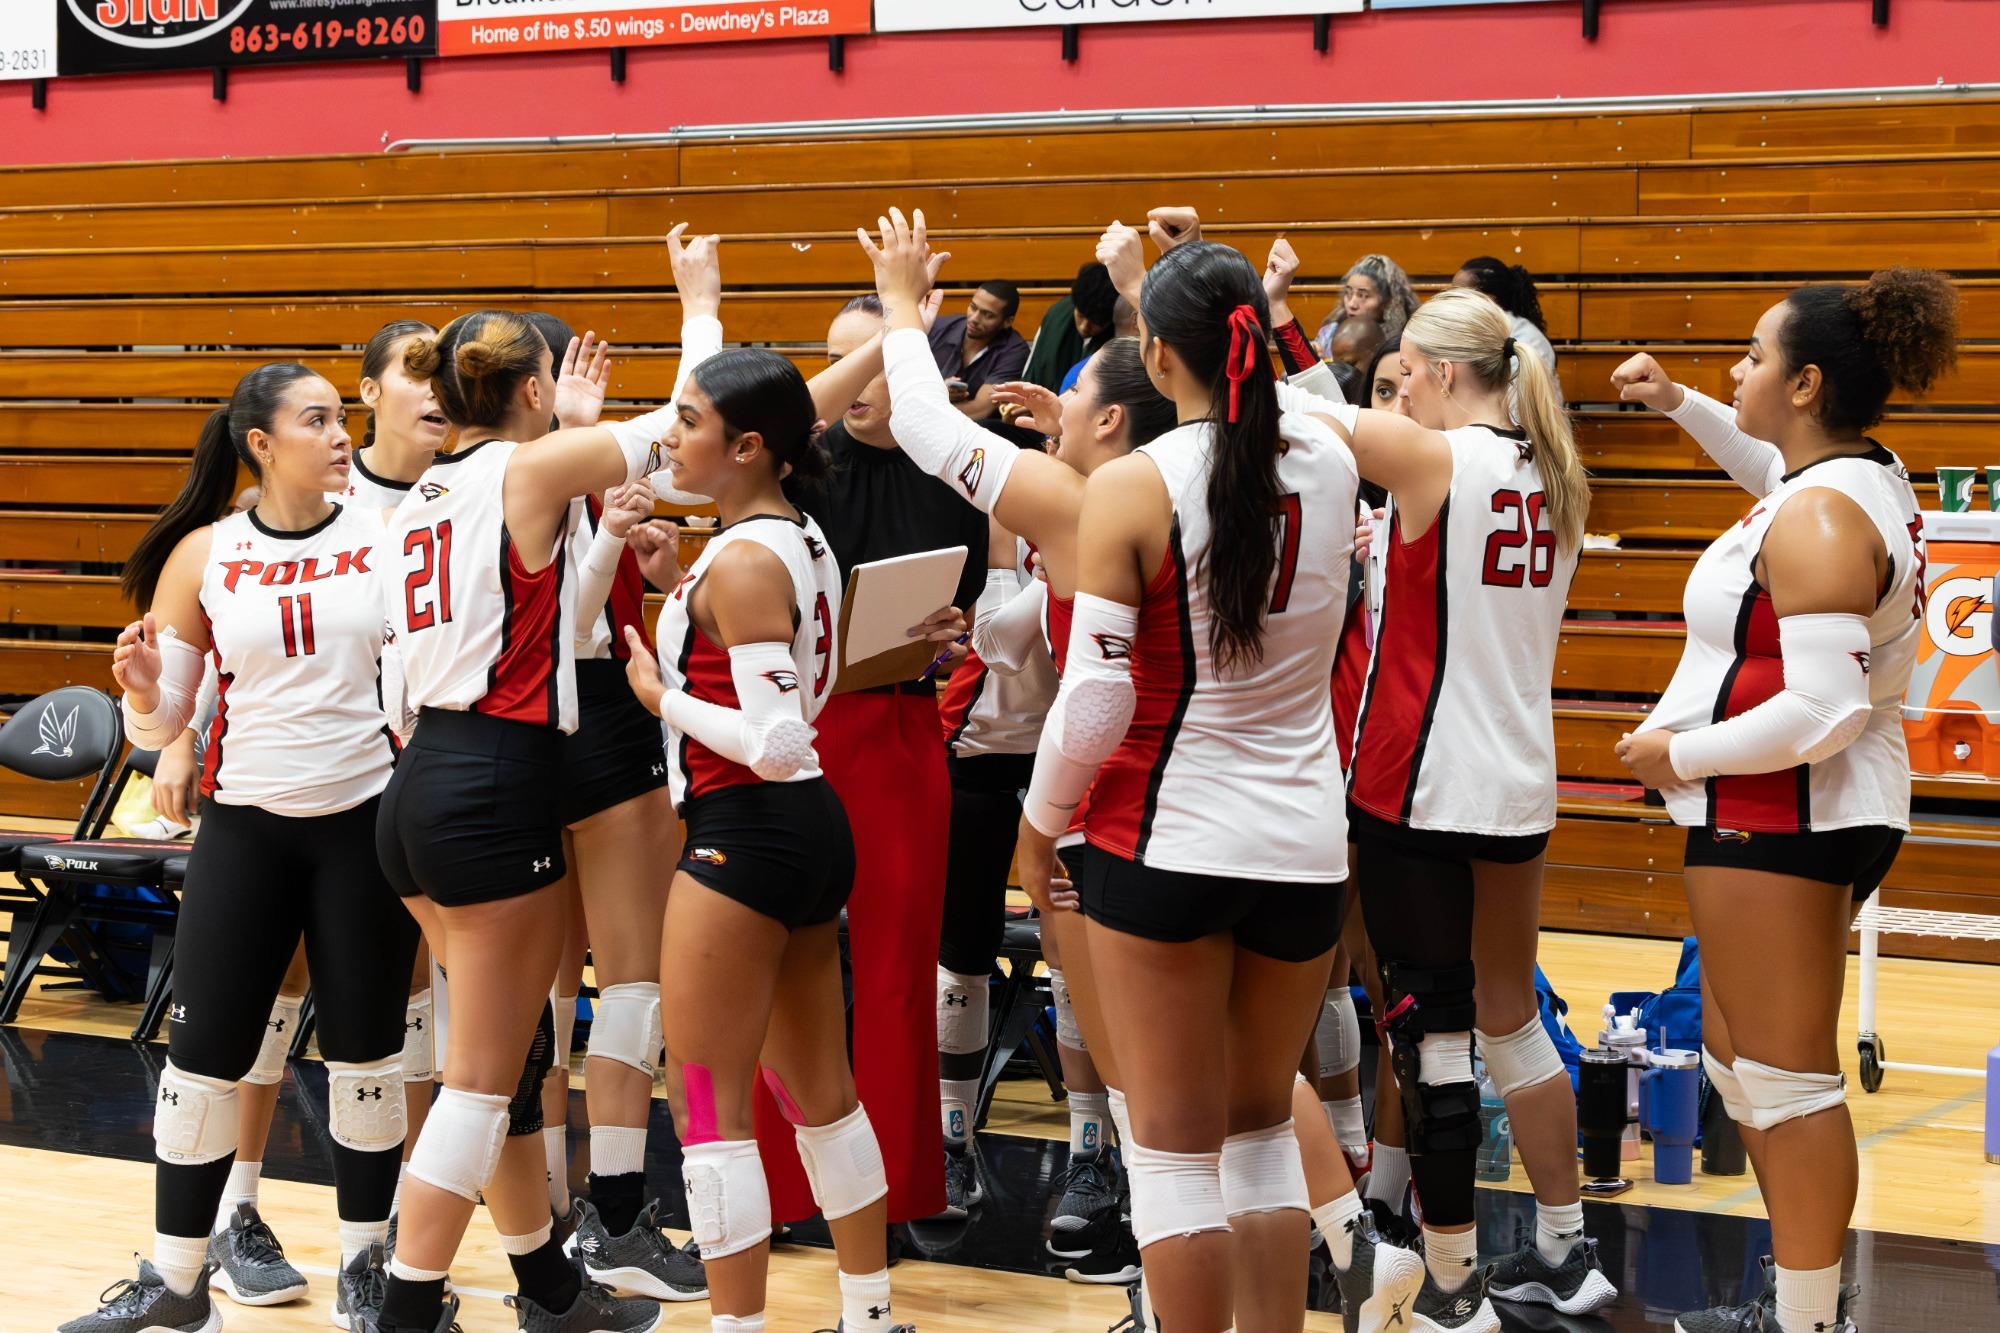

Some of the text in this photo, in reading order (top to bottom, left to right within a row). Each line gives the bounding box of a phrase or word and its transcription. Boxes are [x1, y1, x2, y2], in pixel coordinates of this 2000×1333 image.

[230, 15, 425, 53] 863-619-8260
[471, 6, 829, 44] Home of the $.50 wings Dewdney's Plaza
[1482, 488, 1557, 588] 26
[218, 546, 374, 595] POLK
[403, 519, 453, 634] 21
[278, 592, 316, 658] 11
[813, 591, 833, 699] 3
[65, 858, 99, 871] POLK
